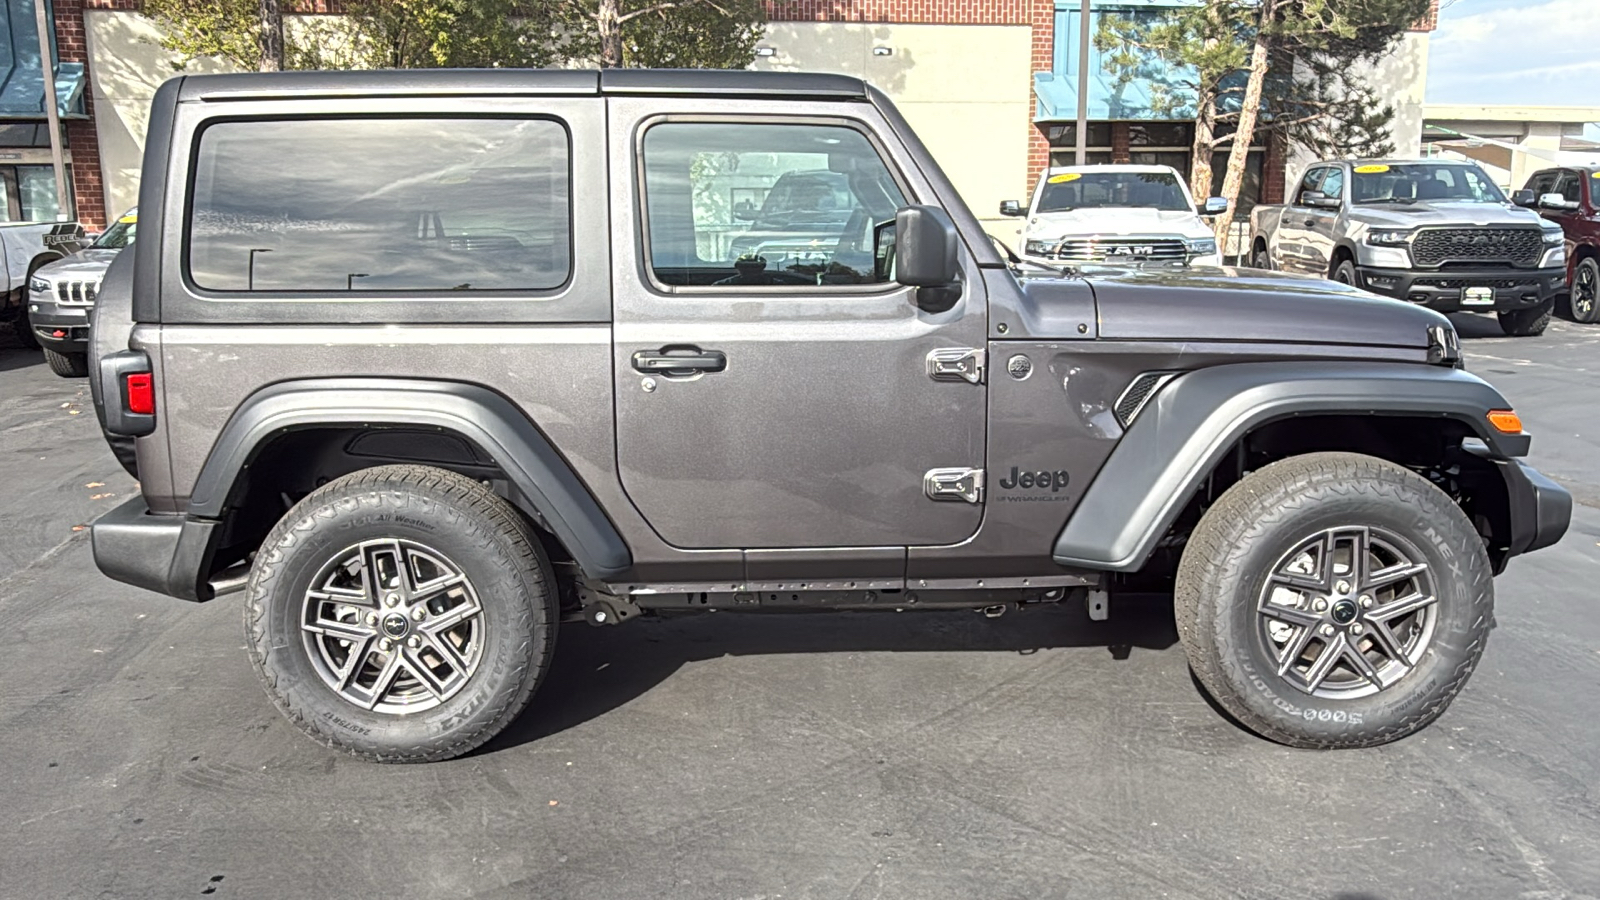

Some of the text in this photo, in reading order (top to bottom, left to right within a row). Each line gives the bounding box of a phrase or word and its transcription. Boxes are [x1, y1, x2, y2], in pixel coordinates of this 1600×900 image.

[999, 466, 1069, 492] Jeep
[377, 514, 436, 531] All Weather
[1422, 526, 1468, 606] NEXE
[441, 687, 489, 731] HTX2
[322, 711, 372, 736] 245/75R17
